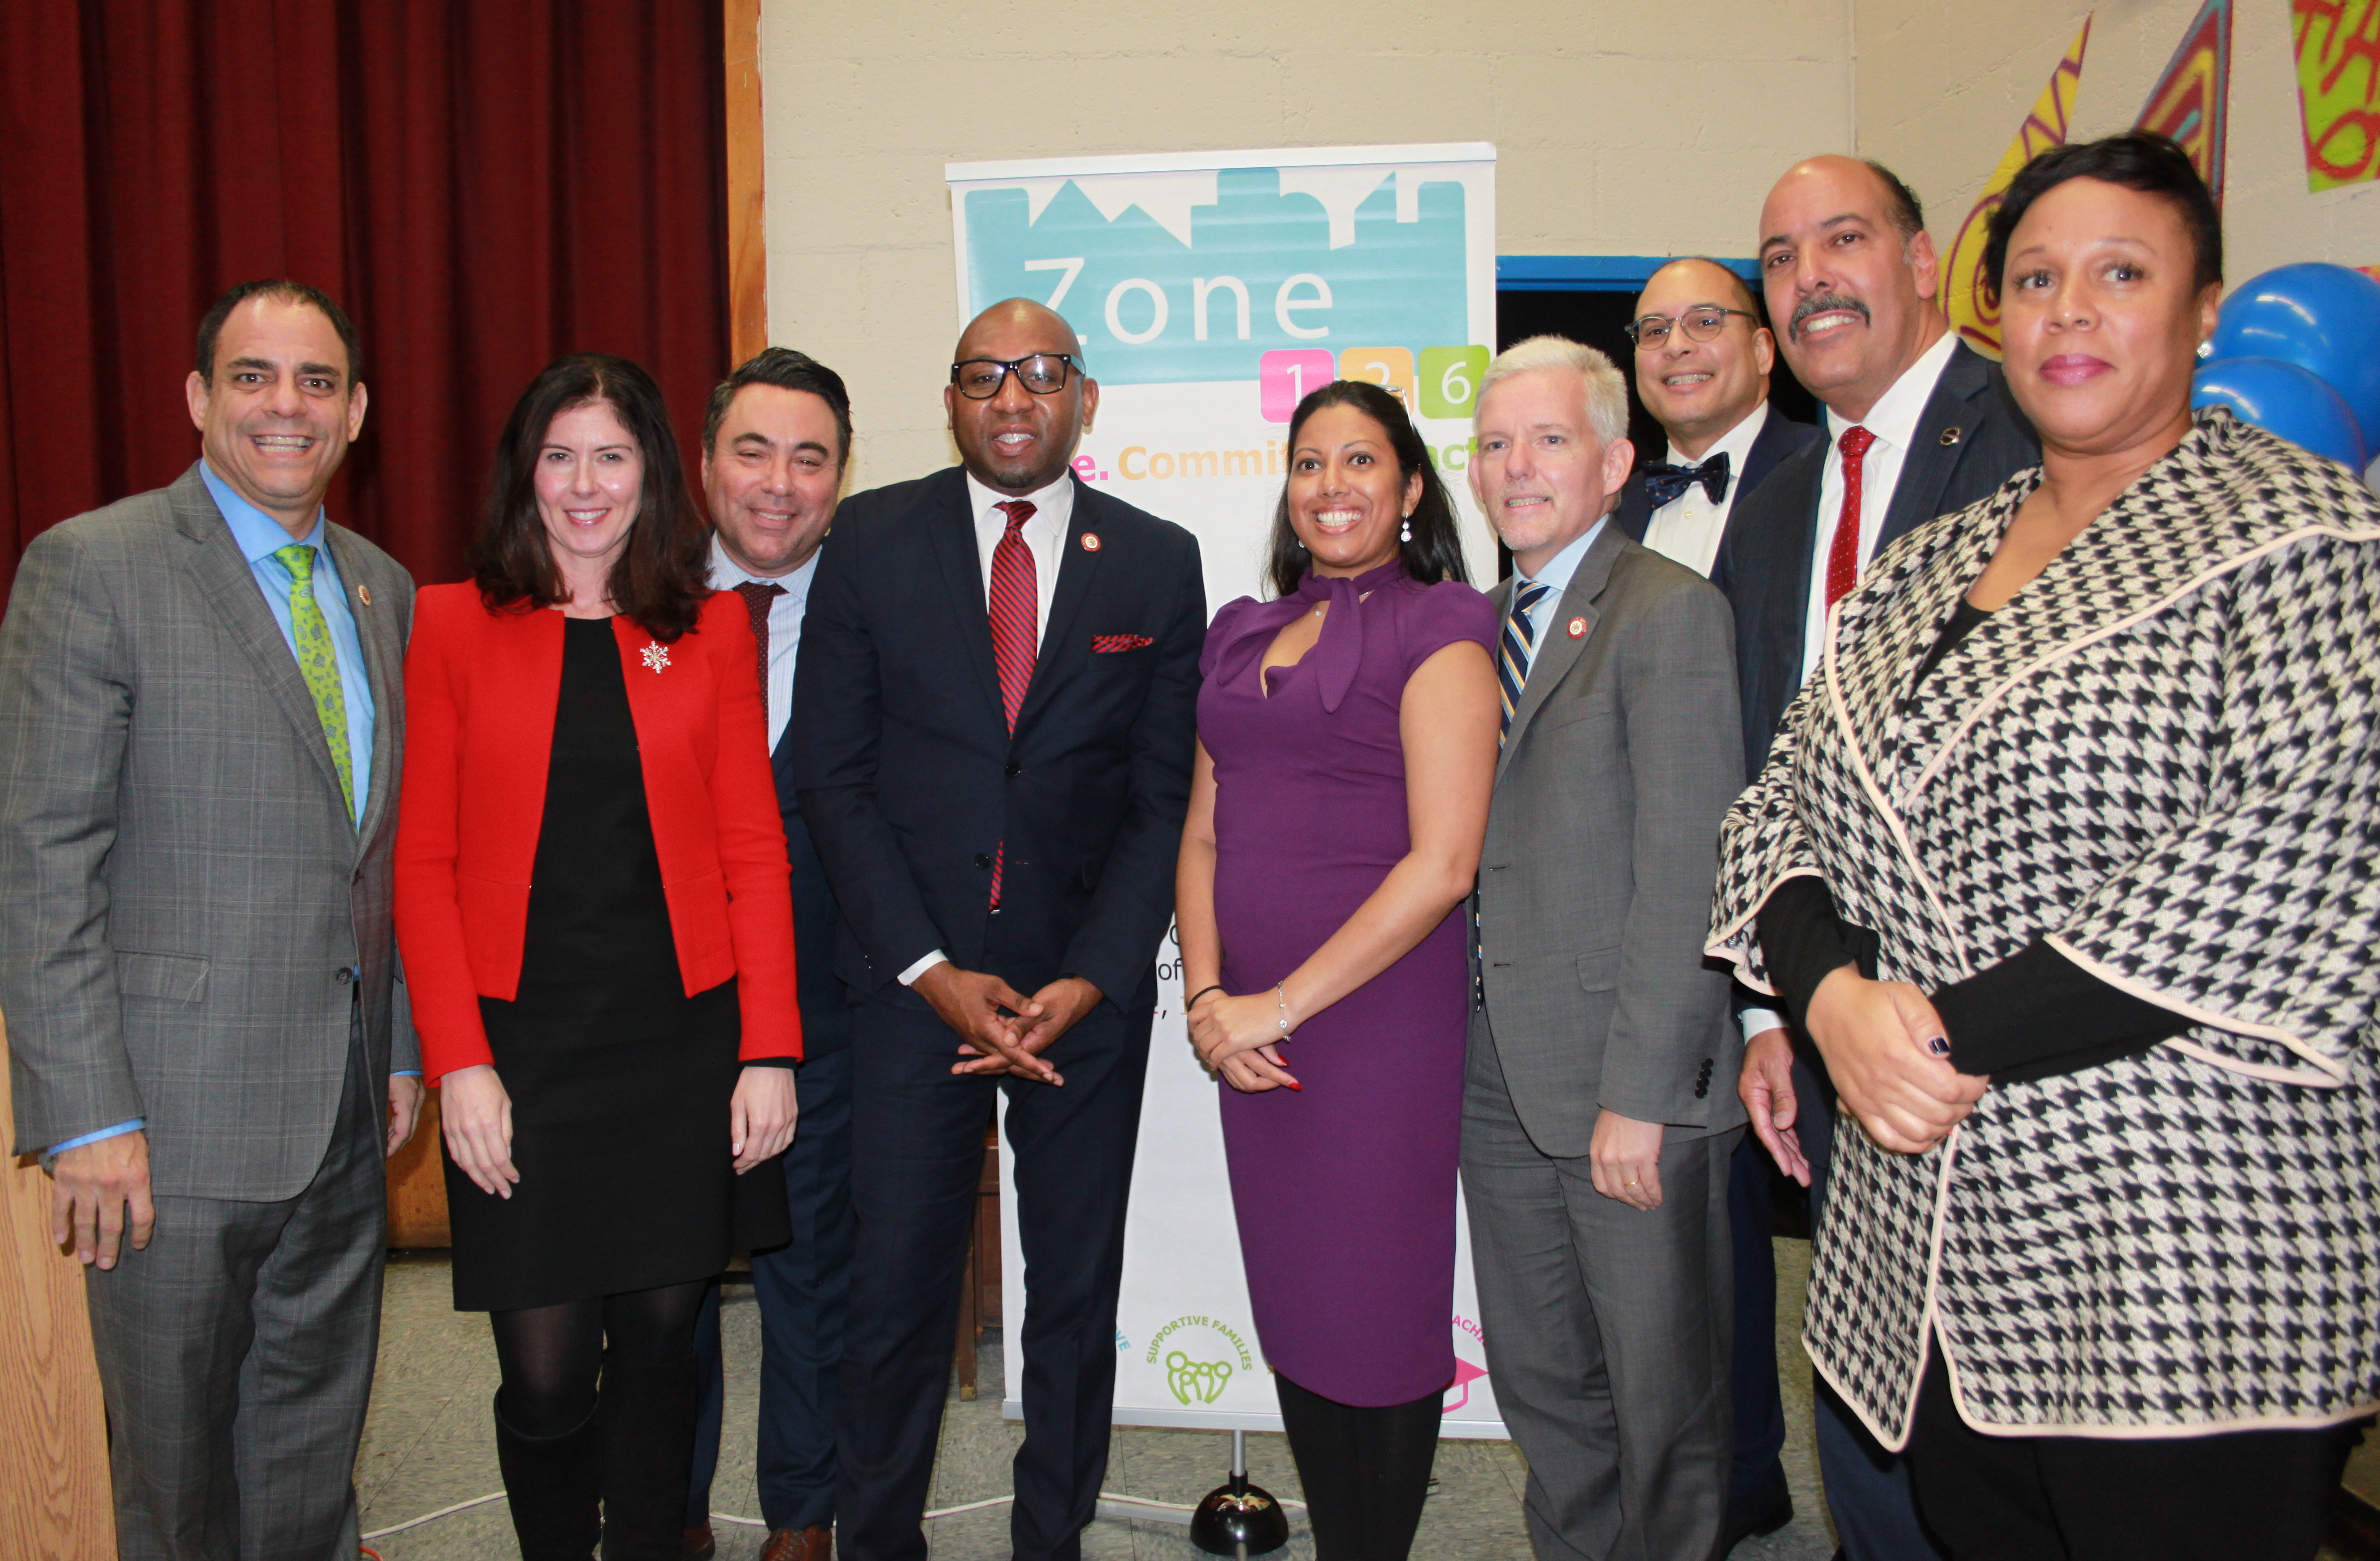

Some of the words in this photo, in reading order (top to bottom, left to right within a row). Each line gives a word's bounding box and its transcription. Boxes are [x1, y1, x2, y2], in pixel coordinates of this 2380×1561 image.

[1025, 258, 1333, 345] Zone
[1158, 957, 1182, 981] of
[1147, 1315, 1209, 1364] SUPPORTIVE
[1212, 1320, 1252, 1371] FAMILIES
